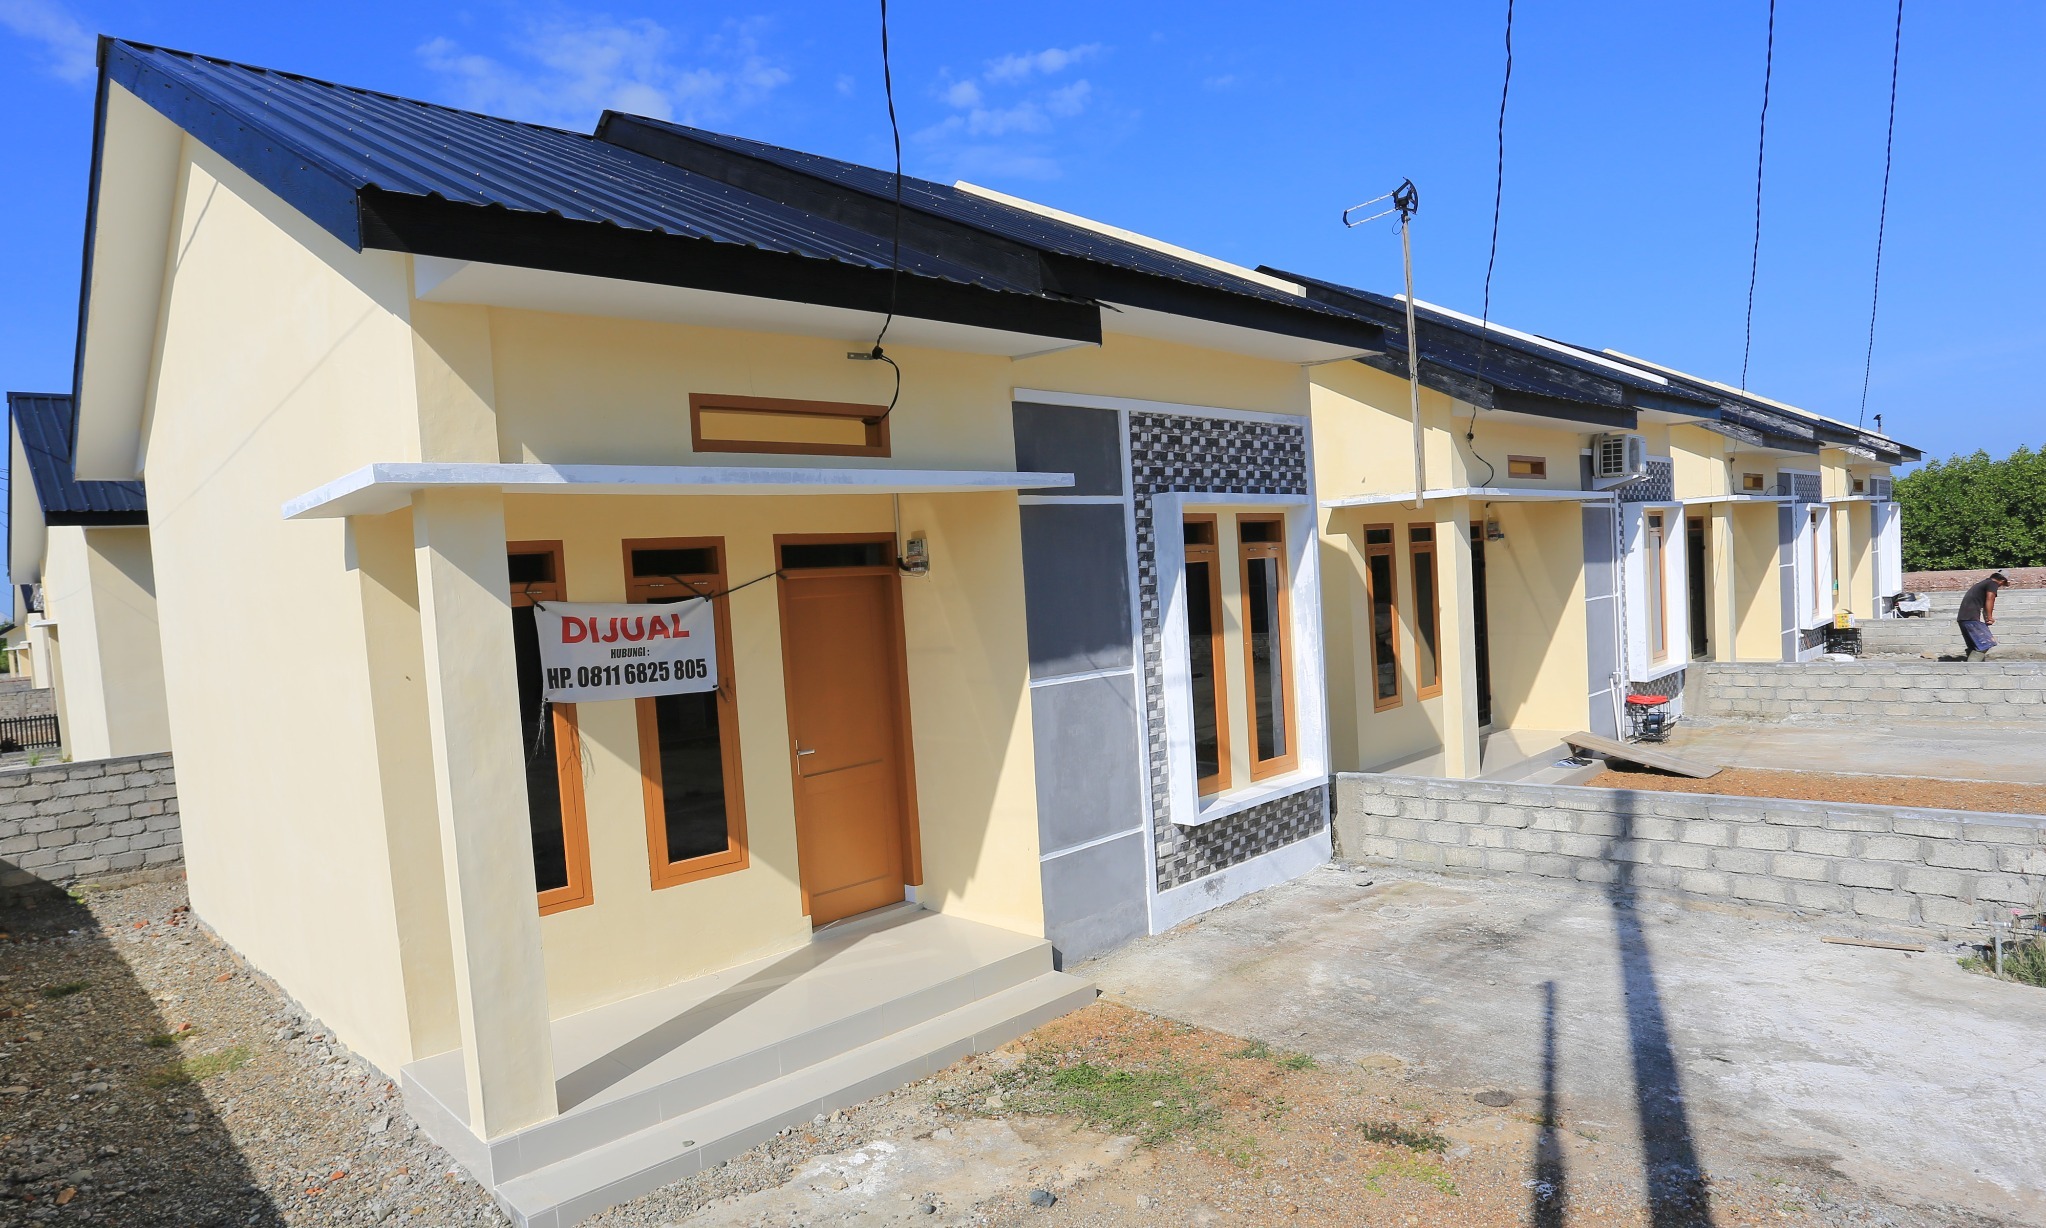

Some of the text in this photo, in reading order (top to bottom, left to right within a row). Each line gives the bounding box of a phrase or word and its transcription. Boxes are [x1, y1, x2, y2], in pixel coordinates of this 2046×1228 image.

[561, 613, 690, 643] DIJUAL
[546, 658, 708, 689] HP. 0811 6825 805
